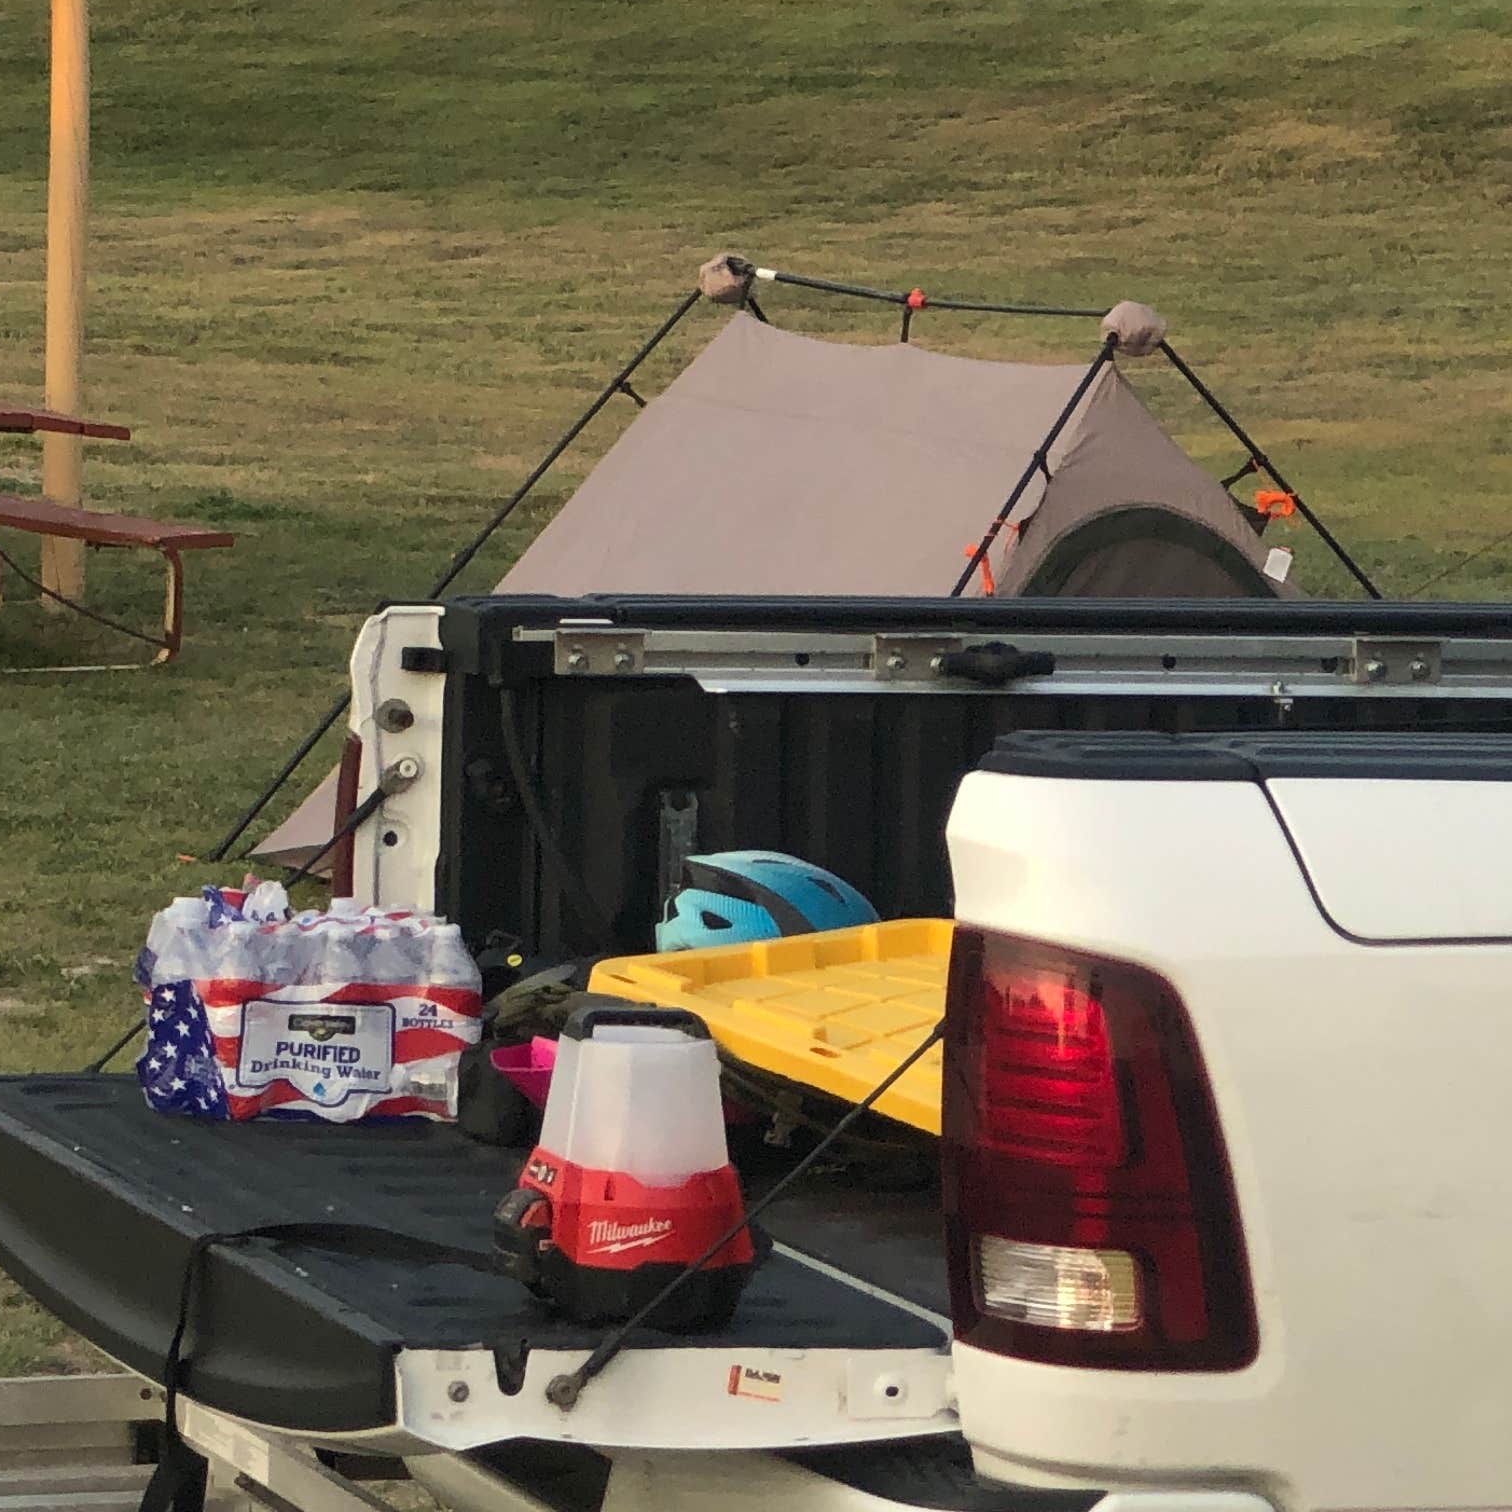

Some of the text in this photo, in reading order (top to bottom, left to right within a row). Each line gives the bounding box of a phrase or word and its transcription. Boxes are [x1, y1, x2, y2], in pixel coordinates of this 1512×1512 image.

[418, 1003, 438, 1017] 24
[402, 1017, 454, 1029] BOTTLES
[276, 1041, 361, 1064] PURIFIED
[250, 1058, 382, 1081] Drinking Water
[587, 1217, 673, 1245] Milwaukee
